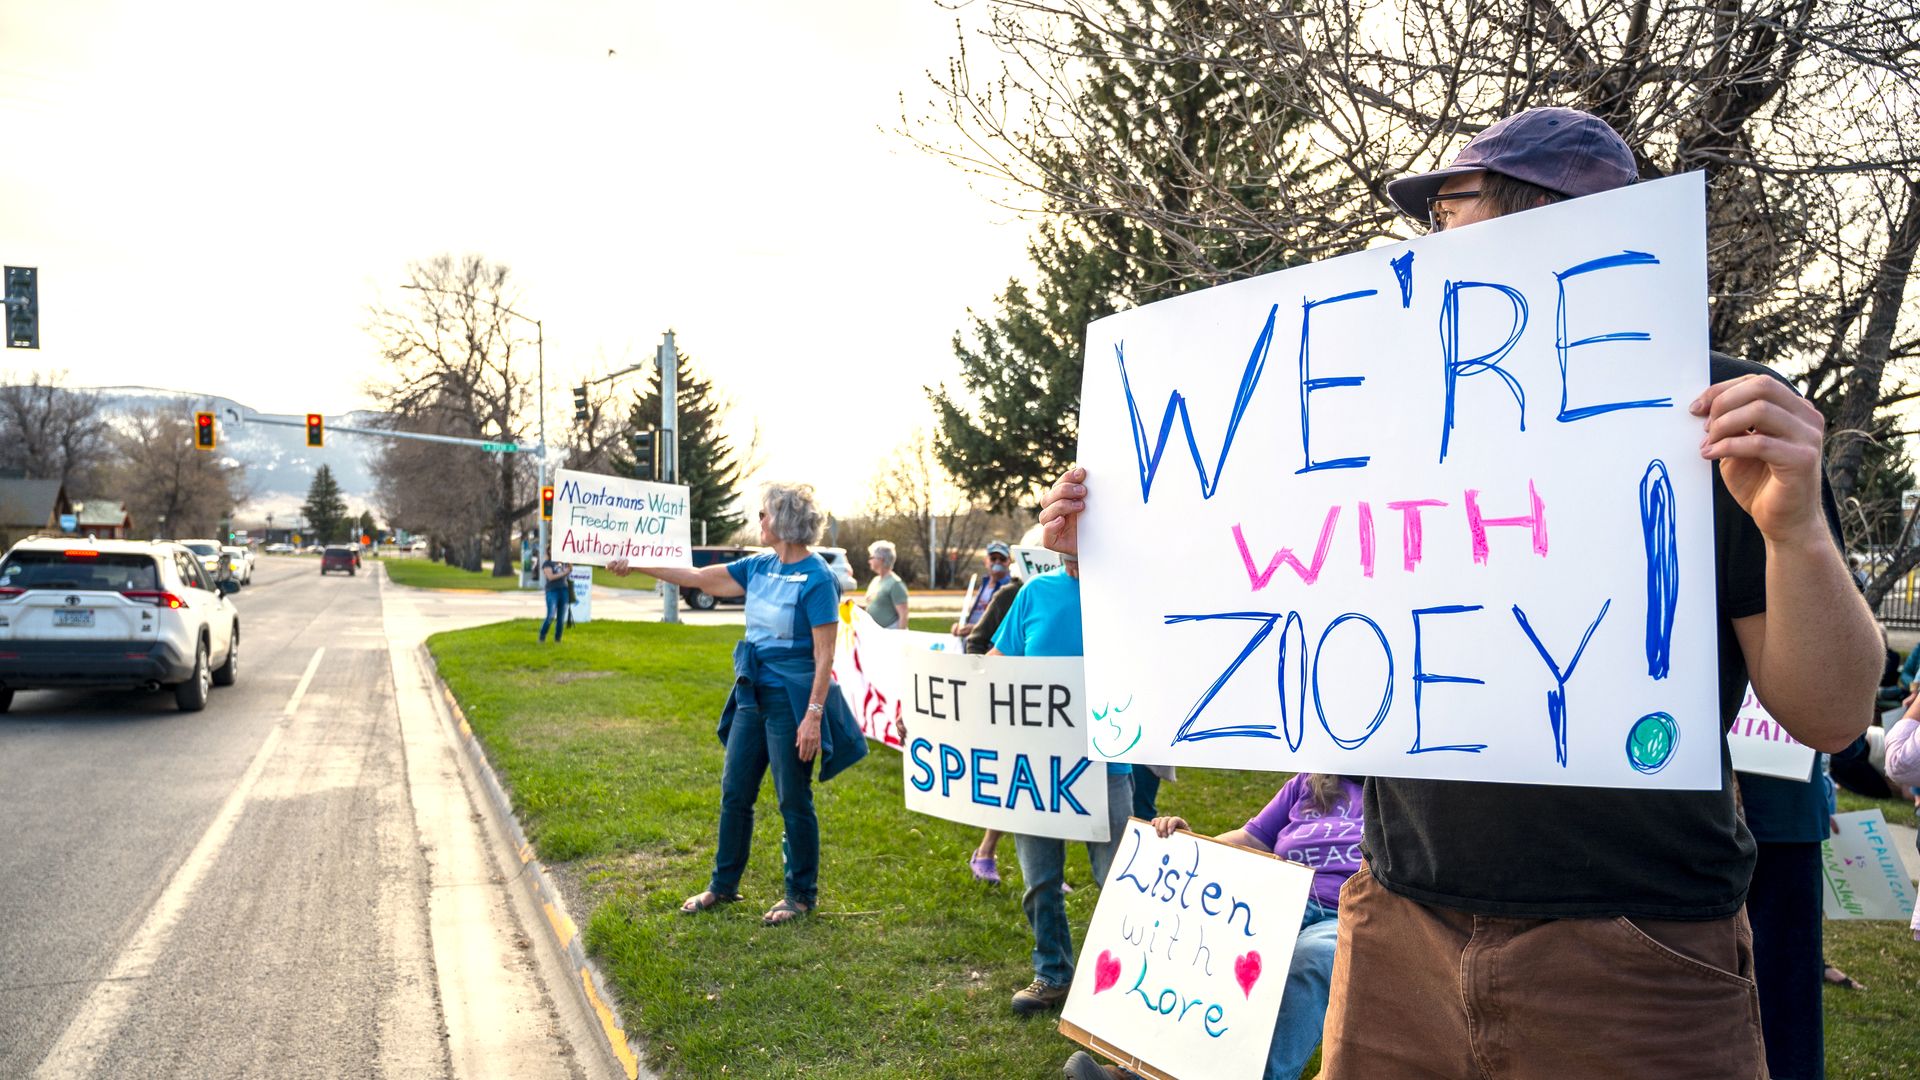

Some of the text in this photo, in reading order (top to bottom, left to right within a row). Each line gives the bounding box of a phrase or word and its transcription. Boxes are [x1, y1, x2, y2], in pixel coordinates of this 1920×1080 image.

[1114, 250, 1675, 504] WE'RE
[559, 480, 687, 516] Montanans Want
[570, 506, 676, 535] Freedom NOT
[561, 529, 683, 557] Authoritarians
[1231, 477, 1550, 592] WITH
[914, 673, 967, 722] LET
[989, 682, 1076, 728] HER
[910, 737, 1094, 817] SPEAK
[1116, 828, 1257, 937] Listen
[1287, 844, 1363, 868] PEAC
[1122, 914, 1213, 977] with
